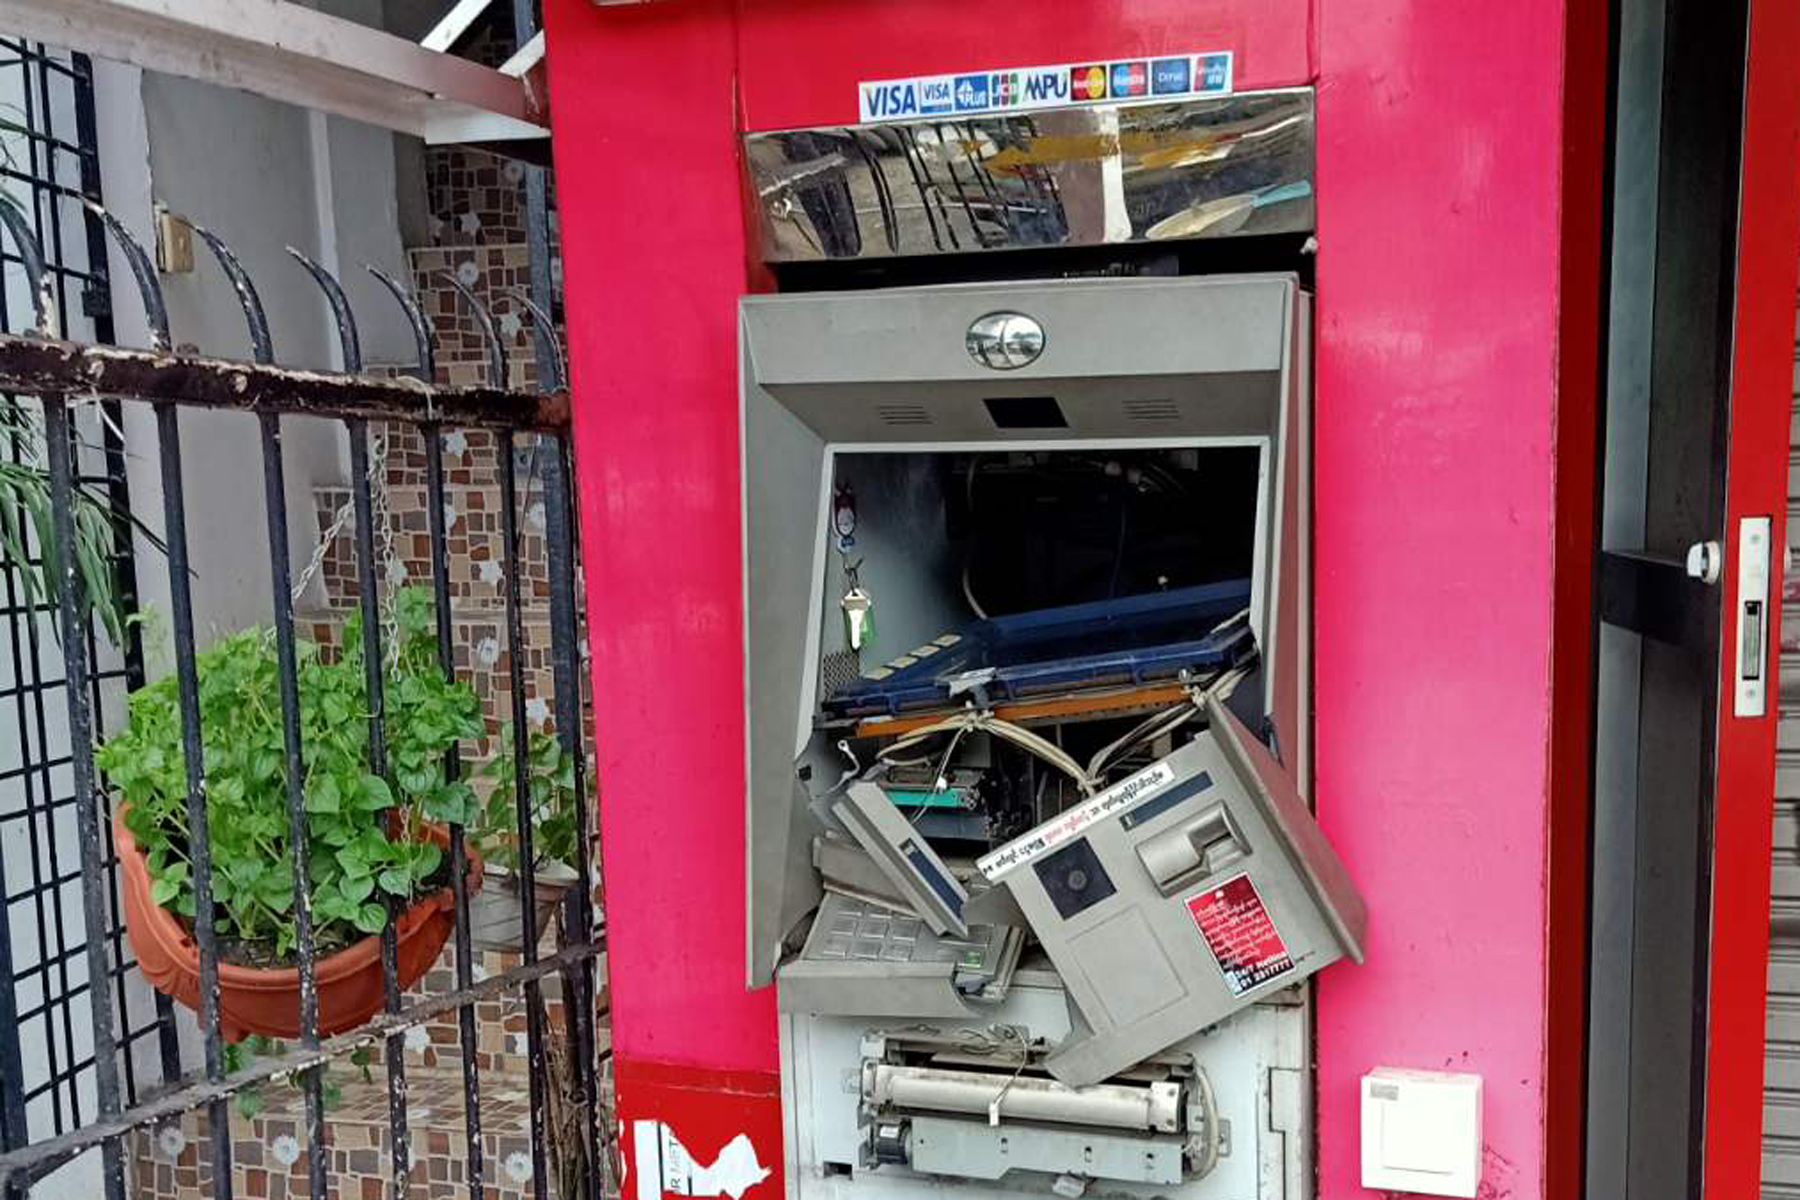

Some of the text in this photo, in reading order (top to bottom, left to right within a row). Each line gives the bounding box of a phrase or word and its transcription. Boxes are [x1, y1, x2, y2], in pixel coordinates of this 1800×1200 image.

[866, 84, 917, 116] VISA
[924, 82, 950, 100] VISA
[1024, 72, 1067, 100] MPU
